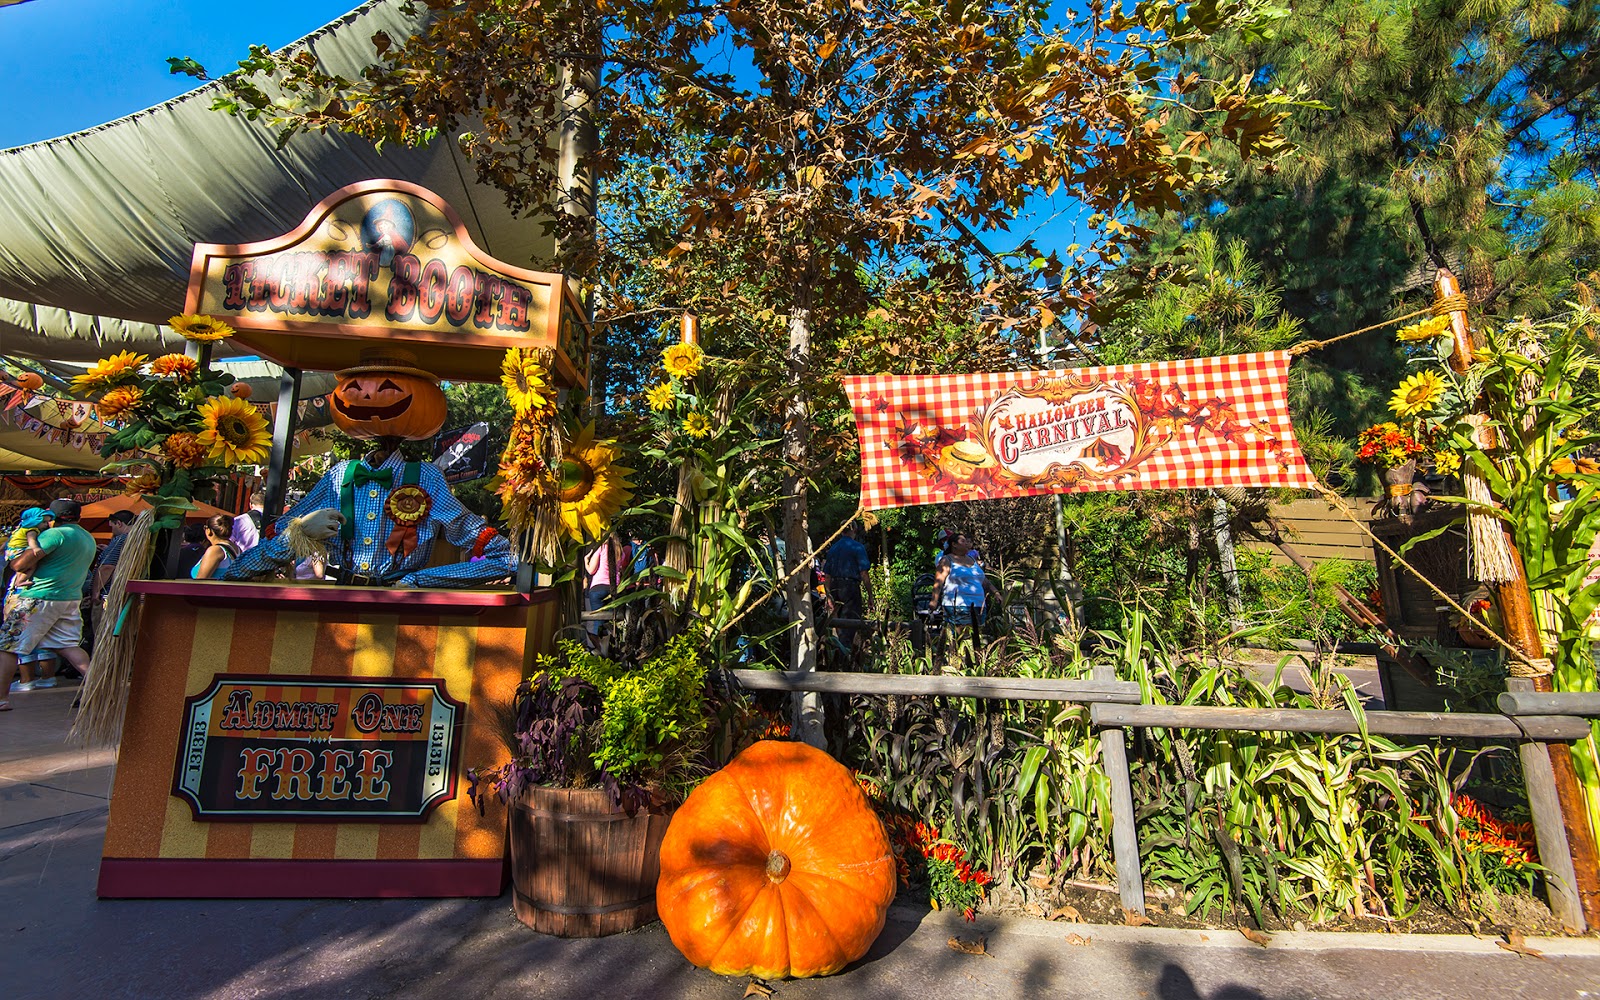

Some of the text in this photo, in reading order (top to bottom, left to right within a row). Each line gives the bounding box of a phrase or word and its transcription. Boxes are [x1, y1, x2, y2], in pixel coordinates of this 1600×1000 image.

[223, 247, 534, 333] TICKET BOOTH
[1000, 408, 1128, 465] CARNIVAL
[1014, 396, 1106, 431] HALLOWEEN
[220, 690, 425, 733] ADMIT ONE
[188, 720, 207, 773] 131313
[428, 723, 445, 778] 131313
[235, 747, 393, 802] FREE
